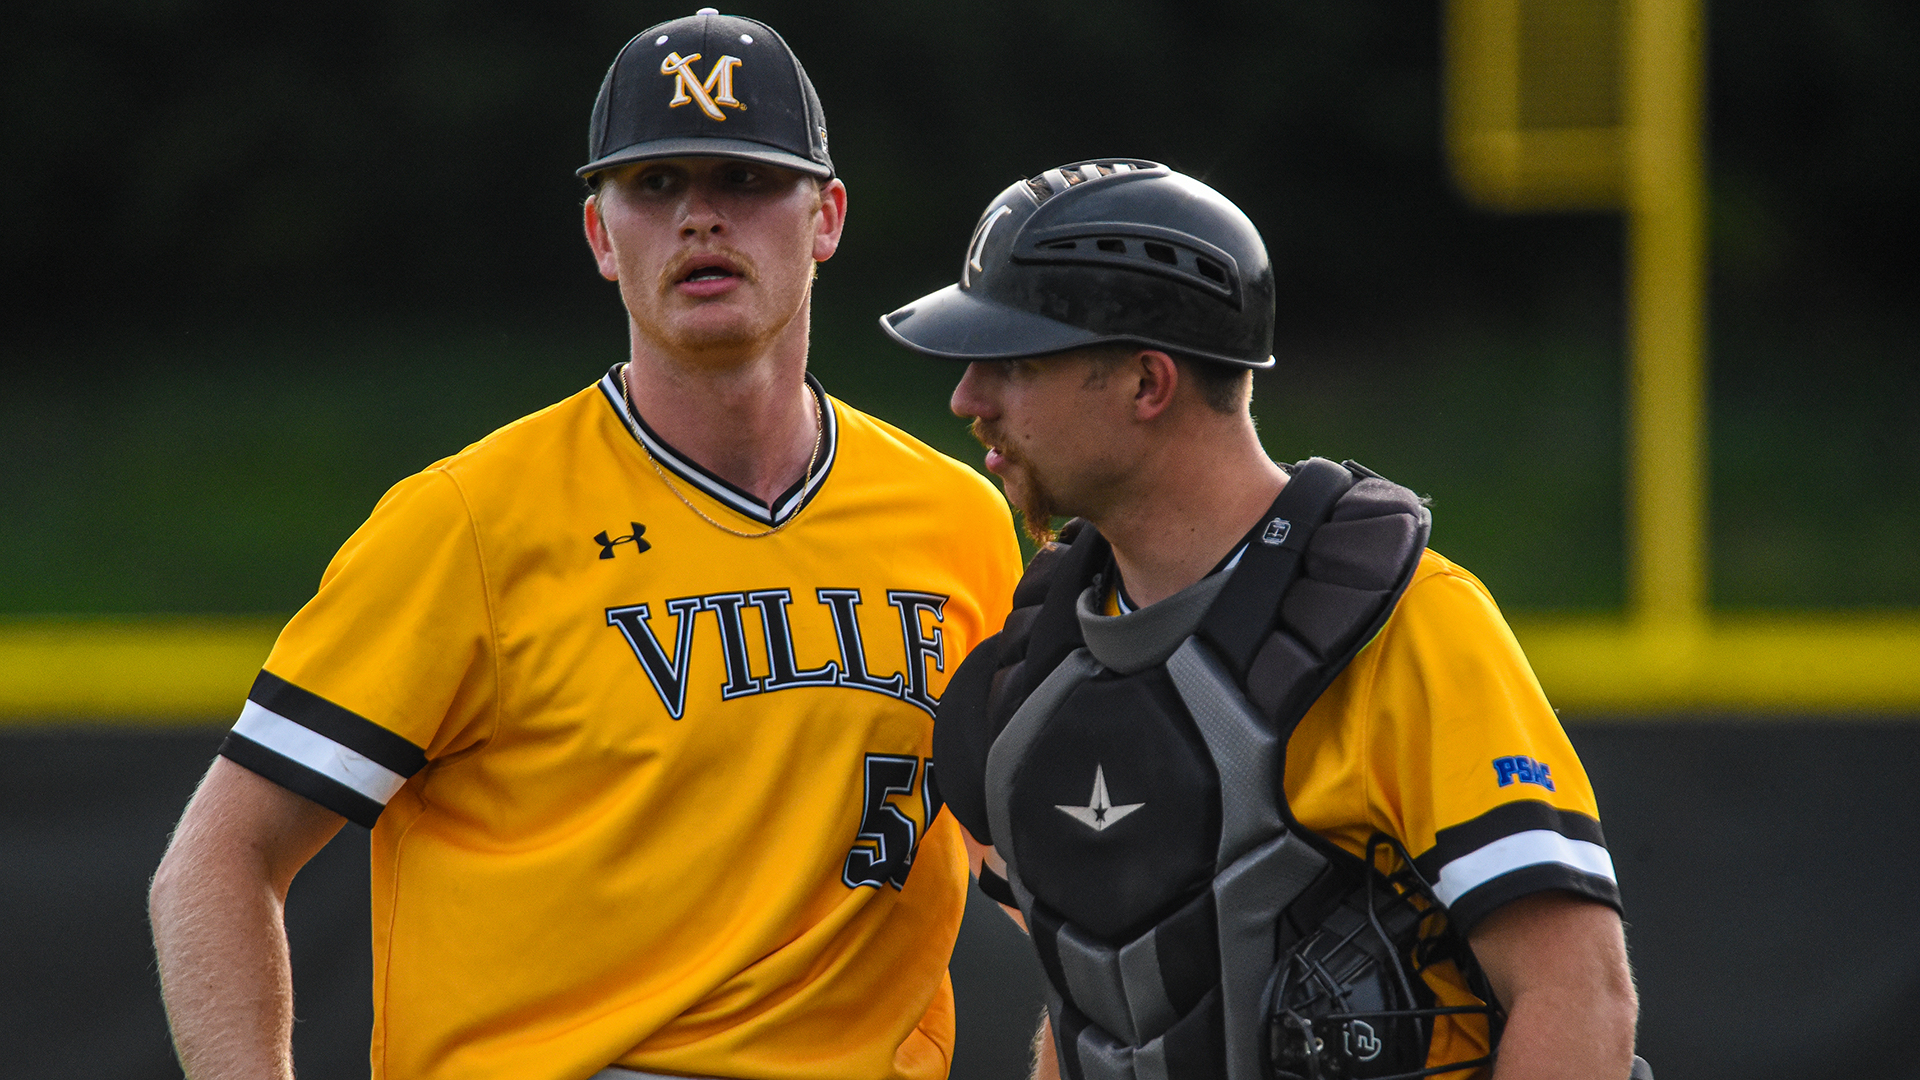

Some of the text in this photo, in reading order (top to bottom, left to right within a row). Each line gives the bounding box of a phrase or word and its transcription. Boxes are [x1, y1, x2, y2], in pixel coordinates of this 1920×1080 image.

[661, 52, 742, 121] M
[605, 587, 950, 720] VILLE
[842, 752, 934, 892] 5
